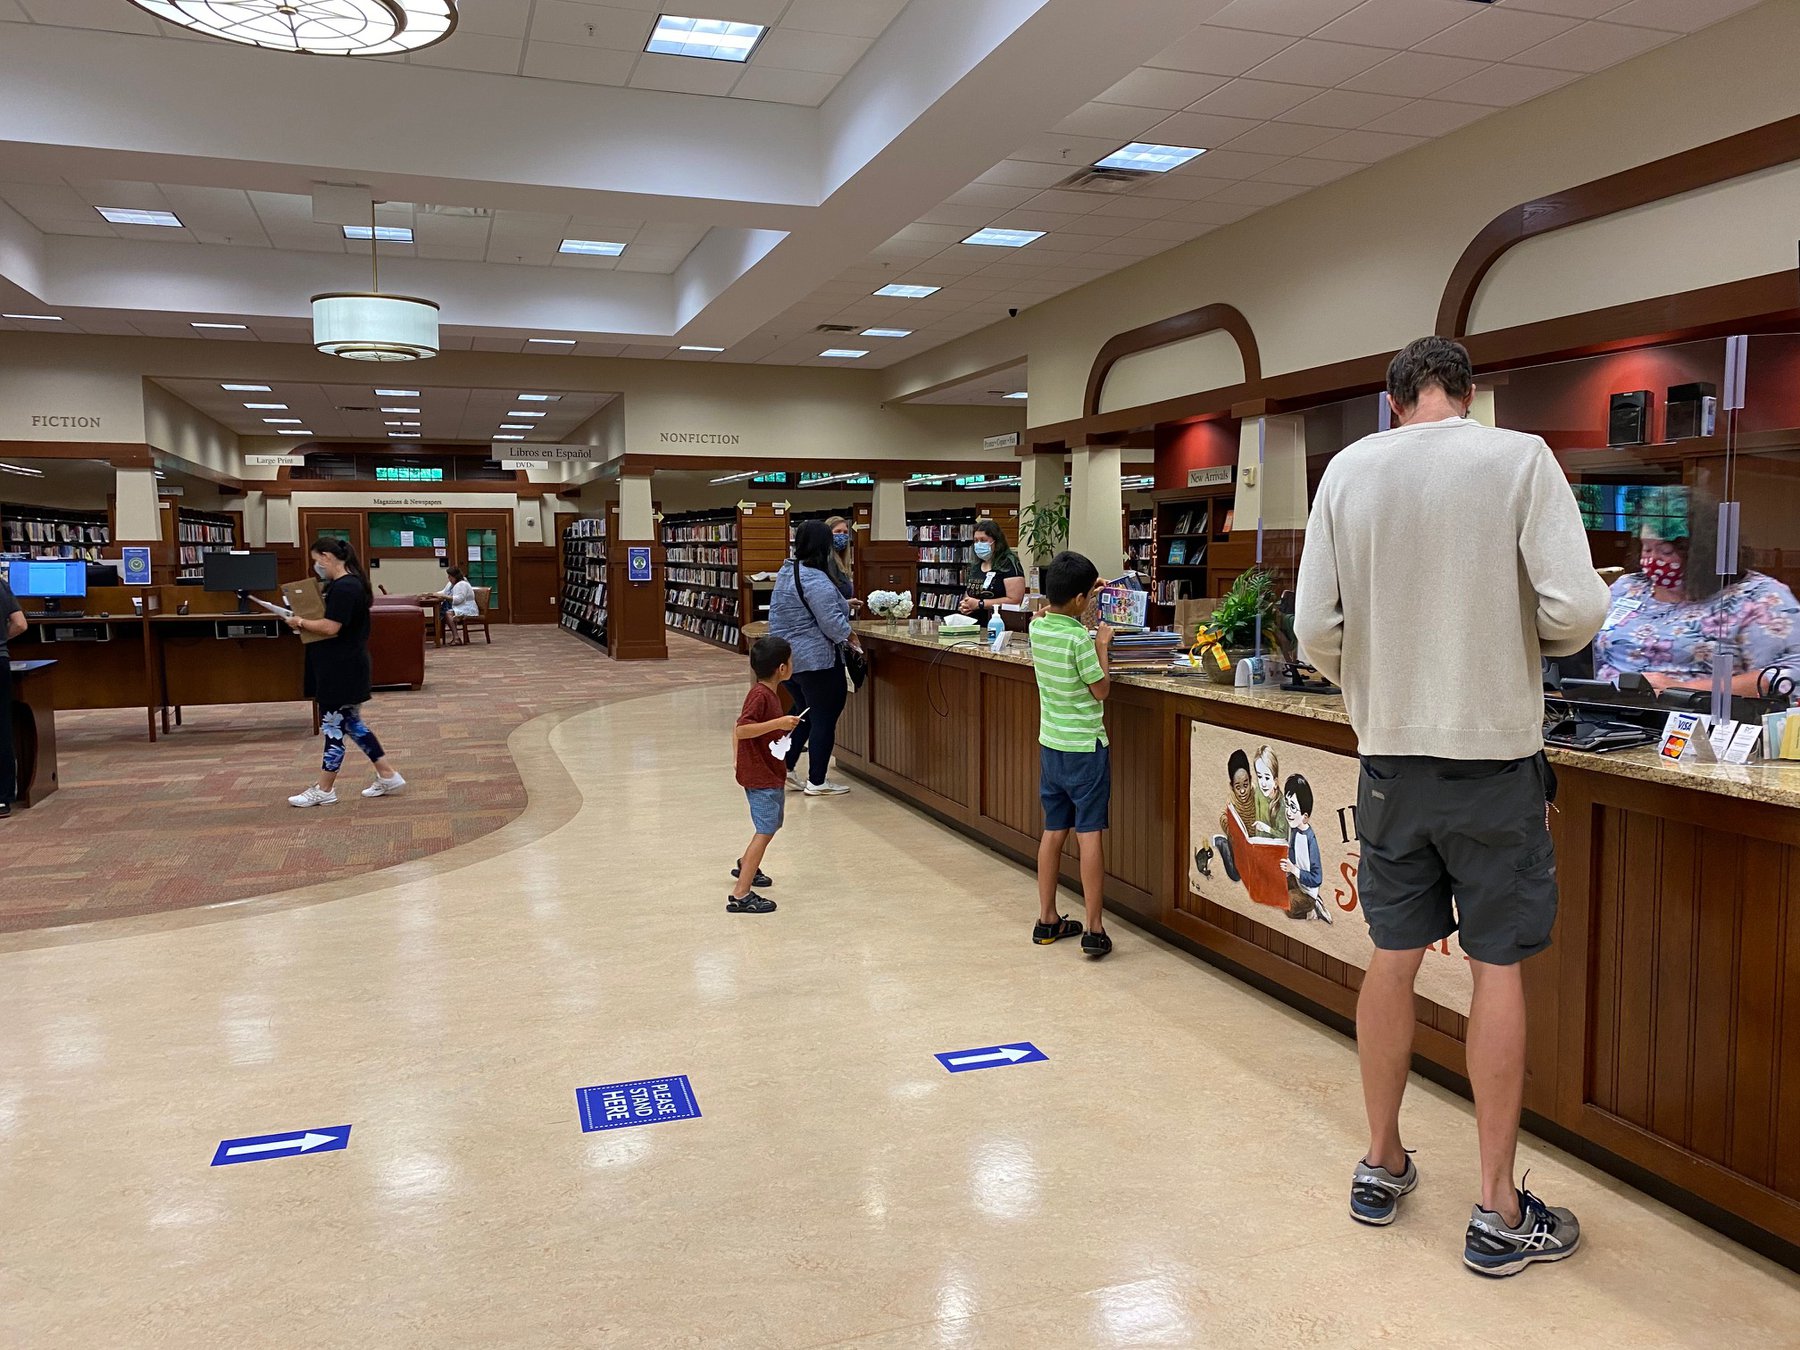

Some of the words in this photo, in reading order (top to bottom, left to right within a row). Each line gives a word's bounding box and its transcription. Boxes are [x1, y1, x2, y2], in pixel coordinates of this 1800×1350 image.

[31, 415, 101, 428] FICTION
[660, 432, 740, 444] NONFICTION
[509, 447, 540, 457] Libros
[556, 448, 592, 459] Español
[256, 457, 276, 465] Large
[1190, 472, 1203, 484] New
[1204, 470, 1229, 482] Arrivals
[373, 498, 402, 506] Magazines
[409, 498, 442, 506] Newspapers
[1678, 720, 1693, 731] VISA
[629, 1087, 653, 1117] STAND
[651, 1083, 677, 1115] PLEASE
[602, 1090, 630, 1121] HERE
